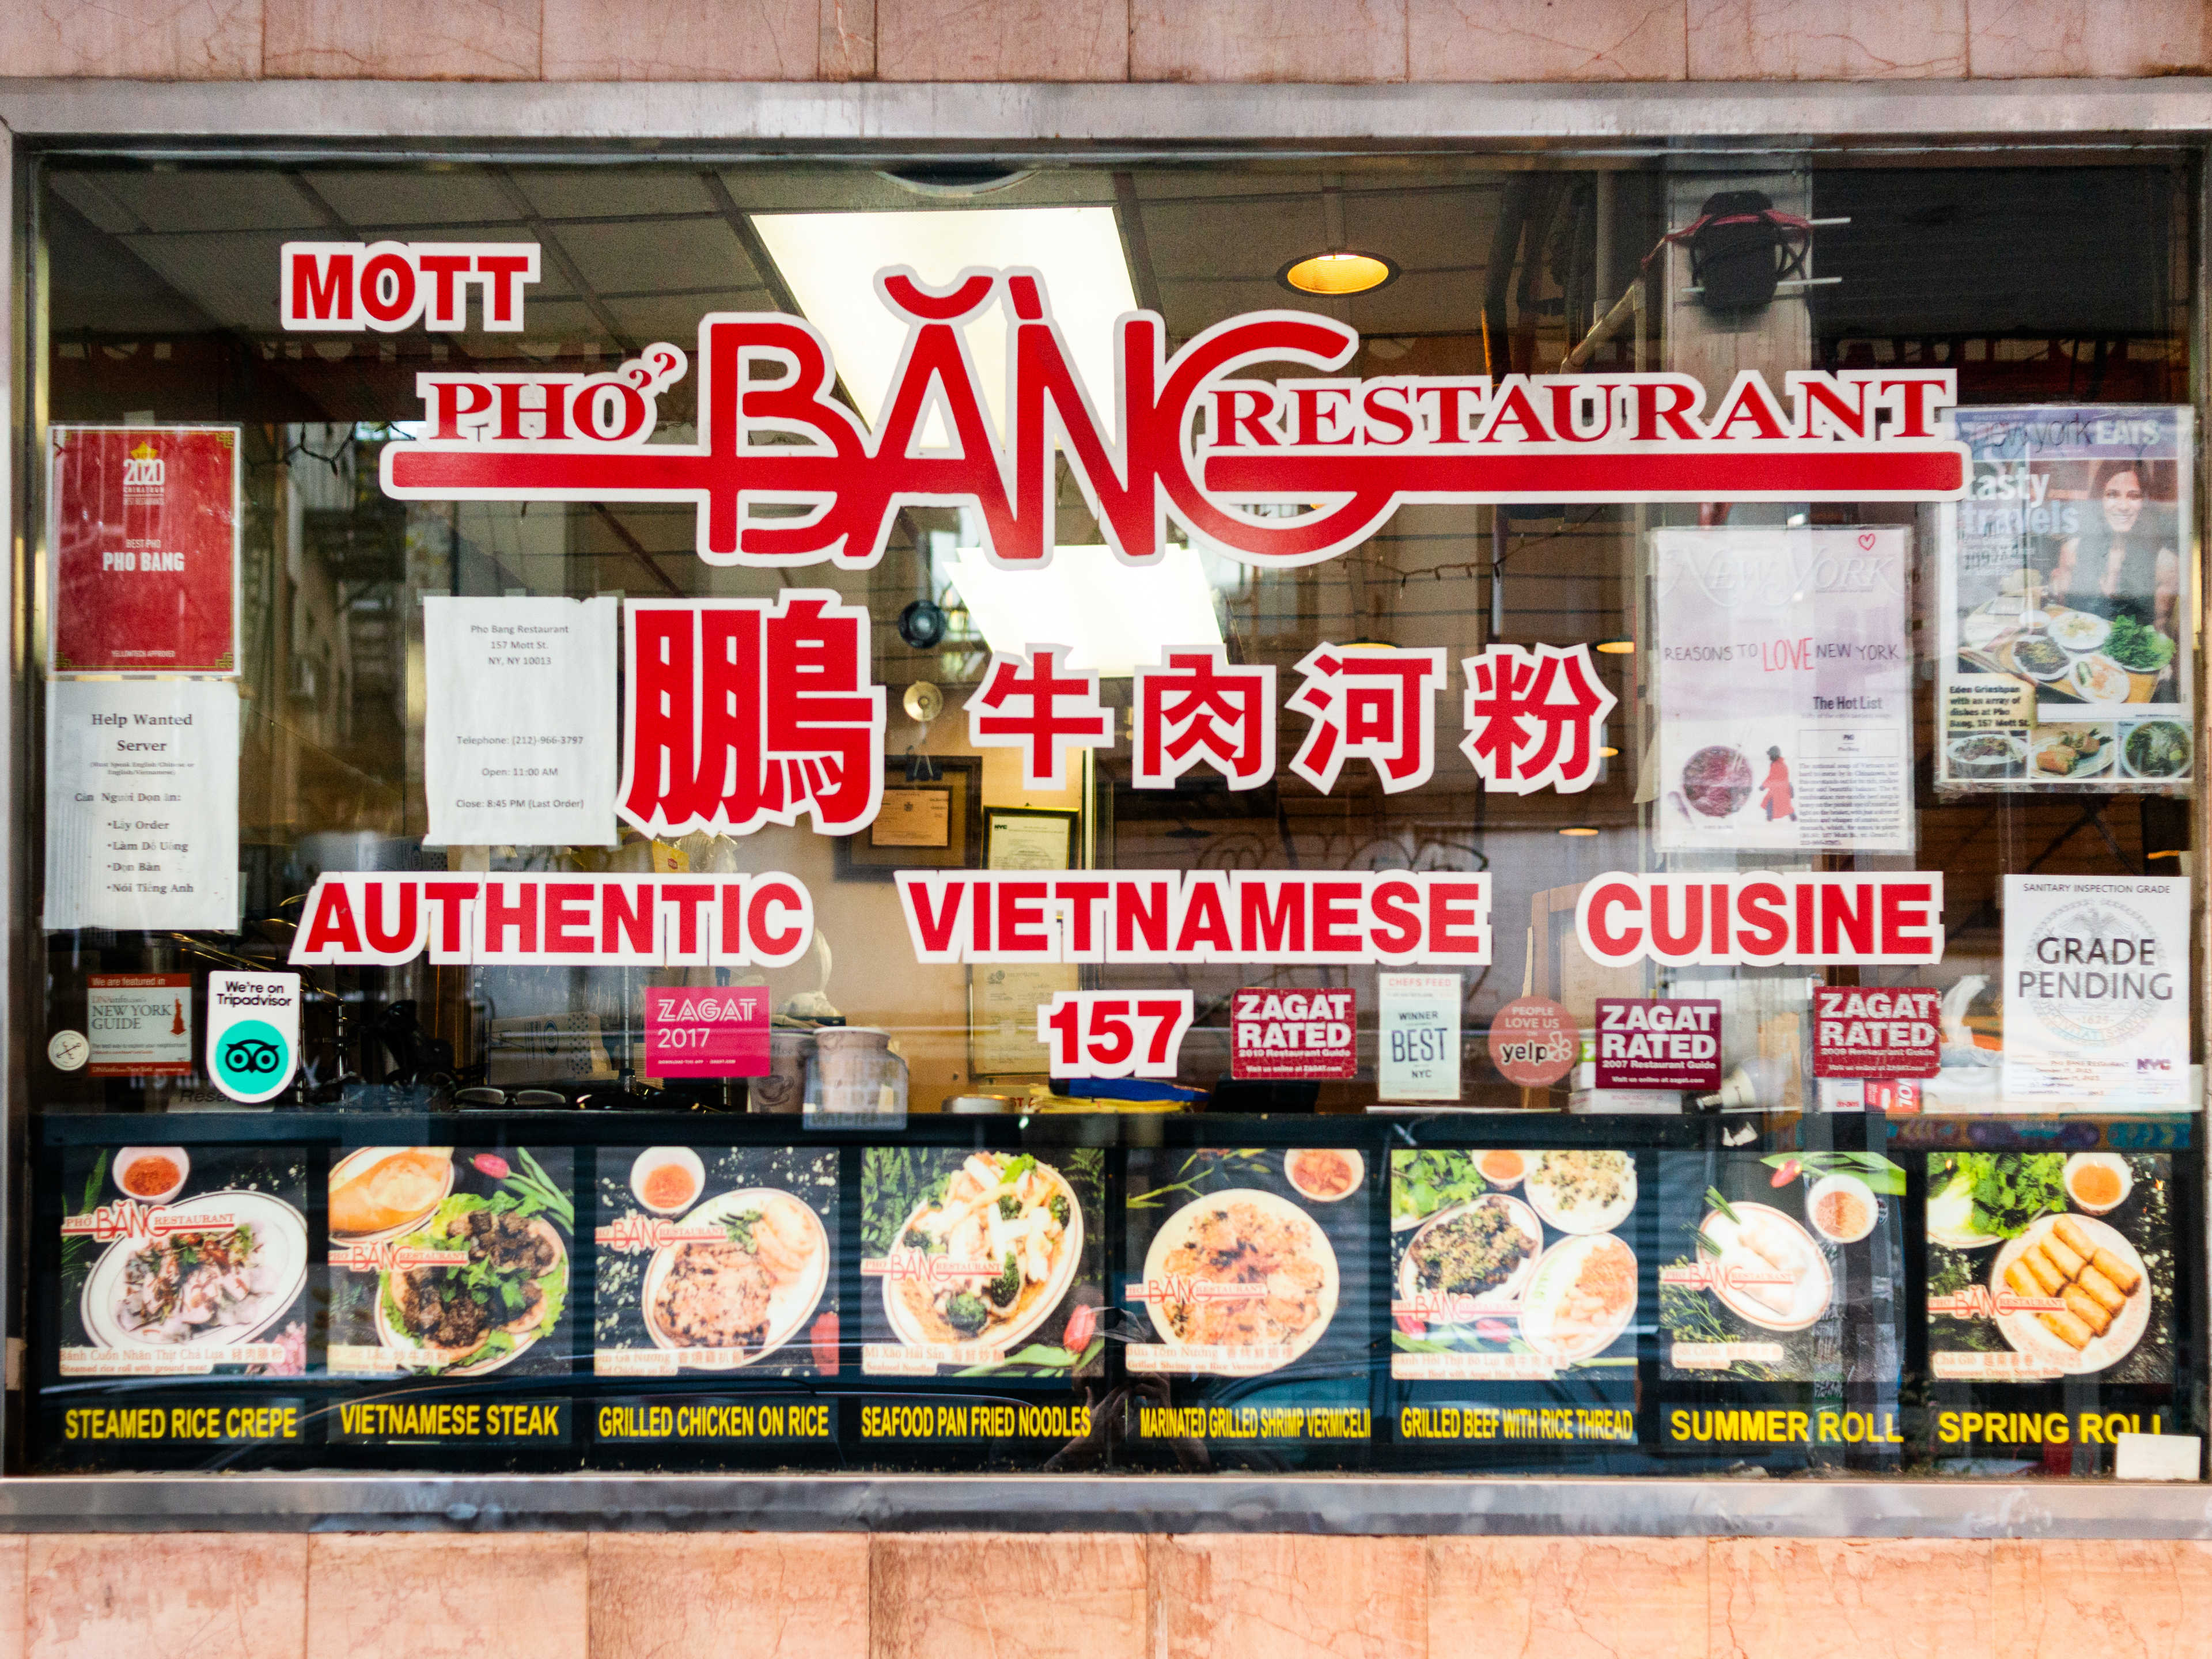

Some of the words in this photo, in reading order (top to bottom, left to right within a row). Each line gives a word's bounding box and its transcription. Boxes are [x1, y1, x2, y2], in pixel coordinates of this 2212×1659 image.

[293, 253, 528, 321] MOTT
[1208, 378, 1948, 446] RESTAURANT
[2097, 420, 2160, 445] EATS
[123, 459, 165, 485] 2020
[126, 539, 144, 548] BEST
[145, 539, 161, 548] PHO
[103, 552, 135, 571] PHO
[141, 552, 184, 571] BANG
[471, 625, 488, 633] Pho
[491, 625, 514, 635] Bang
[518, 625, 569, 634] Restaurant
[491, 641, 507, 650] 157
[511, 641, 534, 650] Mott
[536, 641, 549, 650] St.
[488, 657, 505, 666] NY,
[507, 657, 521, 665] NY
[523, 657, 552, 665] 10013
[1665, 646, 1733, 661] REASONS
[1736, 643, 1758, 658] TO
[1763, 638, 1815, 672] LOVE
[1816, 643, 1852, 660] NEW
[1856, 644, 1900, 661] YORK
[1813, 696, 1834, 709] The
[1836, 696, 1857, 709] Hot
[1860, 696, 1883, 709] List
[637, 599, 872, 824] 鵬
[92, 714, 127, 728] Help
[134, 714, 192, 726] Wanted
[117, 740, 166, 752] Server
[457, 736, 509, 746] Telephone:
[512, 736, 584, 746] (212)-966-3797
[482, 768, 510, 777] Open:
[513, 768, 539, 776] 11:00
[542, 768, 559, 776] AM
[456, 800, 484, 808] Close:
[487, 800, 507, 808] 8:45
[510, 800, 525, 808] PM
[528, 799, 551, 809] (Last
[554, 799, 584, 809] Order)
[135, 820, 169, 830] Order
[171, 883, 194, 892] Anh
[2023, 883, 2071, 893] SANITARY
[2074, 884, 2133, 893] INSPECTION
[2136, 885, 2171, 894] GRADE
[304, 882, 803, 956] AUTHENTIC
[908, 881, 1479, 954] VIETNAMESE
[1587, 882, 1933, 956] CUISINE
[2037, 936, 2156, 966] GRADE
[92, 978, 105, 986] We
[123, 977, 156, 986] featured
[158, 977, 166, 985] in
[225, 980, 263, 993] We're
[268, 983, 284, 994] on
[1389, 978, 1422, 987] CHEFS
[1425, 978, 1452, 987] FEED
[2018, 971, 2173, 1001] PENDING
[217, 994, 292, 1007] Tripadvisor
[1237, 994, 1347, 1021] ZAGAT
[1820, 993, 1937, 1019] ZAGAT
[92, 1005, 128, 1016] NEW
[130, 1004, 172, 1016] YORK
[657, 998, 757, 1022] ZAGAT
[1399, 1010, 1438, 1021] WINNER
[1512, 1006, 1554, 1016] PEOPLE
[92, 1018, 142, 1029] GUIDE
[1505, 1017, 1540, 1028] LOVE
[1543, 1018, 1560, 1028] US
[1602, 1005, 1717, 1032] ZAGAT
[657, 1028, 710, 1048] 2017
[1050, 1000, 1182, 1065] 157
[1237, 1022, 1351, 1048] RATED
[1820, 1021, 1936, 1047] RATED
[1392, 1027, 1448, 1062] BEST
[1603, 1034, 1717, 1059] RATED
[1238, 1048, 1264, 1058] 2010
[1266, 1048, 1321, 1058] Restaurant
[1321, 1048, 1351, 1057] Guide
[1502, 1041, 1548, 1065] yelp
[1848, 1048, 1905, 1056] Restaurant
[1906, 1048, 1936, 1056] Guide
[1602, 1060, 1628, 1069] 2007
[1630, 1060, 1685, 1069] Restaurant
[1687, 1061, 1717, 1070] Guide
[2137, 1058, 2171, 1070] NYC
[1411, 1070, 1432, 1078] NYC
[154, 1213, 235, 1224] RESTAURANT
[155, 1365, 184, 1374] ground
[866, 1364, 899, 1372] Seafood
[903, 1365, 934, 1373] Noodles
[65, 1408, 165, 1439] STEAMED
[171, 1408, 220, 1438] RICE
[226, 1407, 297, 1438] CREPE
[340, 1404, 480, 1435] VIETNAMESE
[486, 1405, 560, 1436] STEAK
[599, 1406, 673, 1437] GRILLED
[677, 1406, 754, 1437] CHICKEN
[758, 1406, 783, 1437] ON
[789, 1405, 829, 1437] RICE
[861, 1406, 934, 1437] SEAFOOD
[938, 1406, 967, 1437] PAN
[971, 1406, 1015, 1437] FRIED
[1019, 1406, 1092, 1437] NOODLES
[1140, 1407, 1207, 1438] MARINATED
[1209, 1407, 1259, 1438] GRILLED
[1260, 1407, 1304, 1438] SHRIMP
[1401, 1407, 1460, 1438] GRILLED
[1464, 1407, 1499, 1438] BEEF
[1502, 1408, 1537, 1439] WITH
[1540, 1408, 1573, 1439] RICE
[1576, 1409, 1633, 1440] THREAD
[1671, 1410, 1809, 1442] SUMMER
[1819, 1411, 1904, 1443] ROLL
[1938, 1412, 2070, 1444] SPRING
